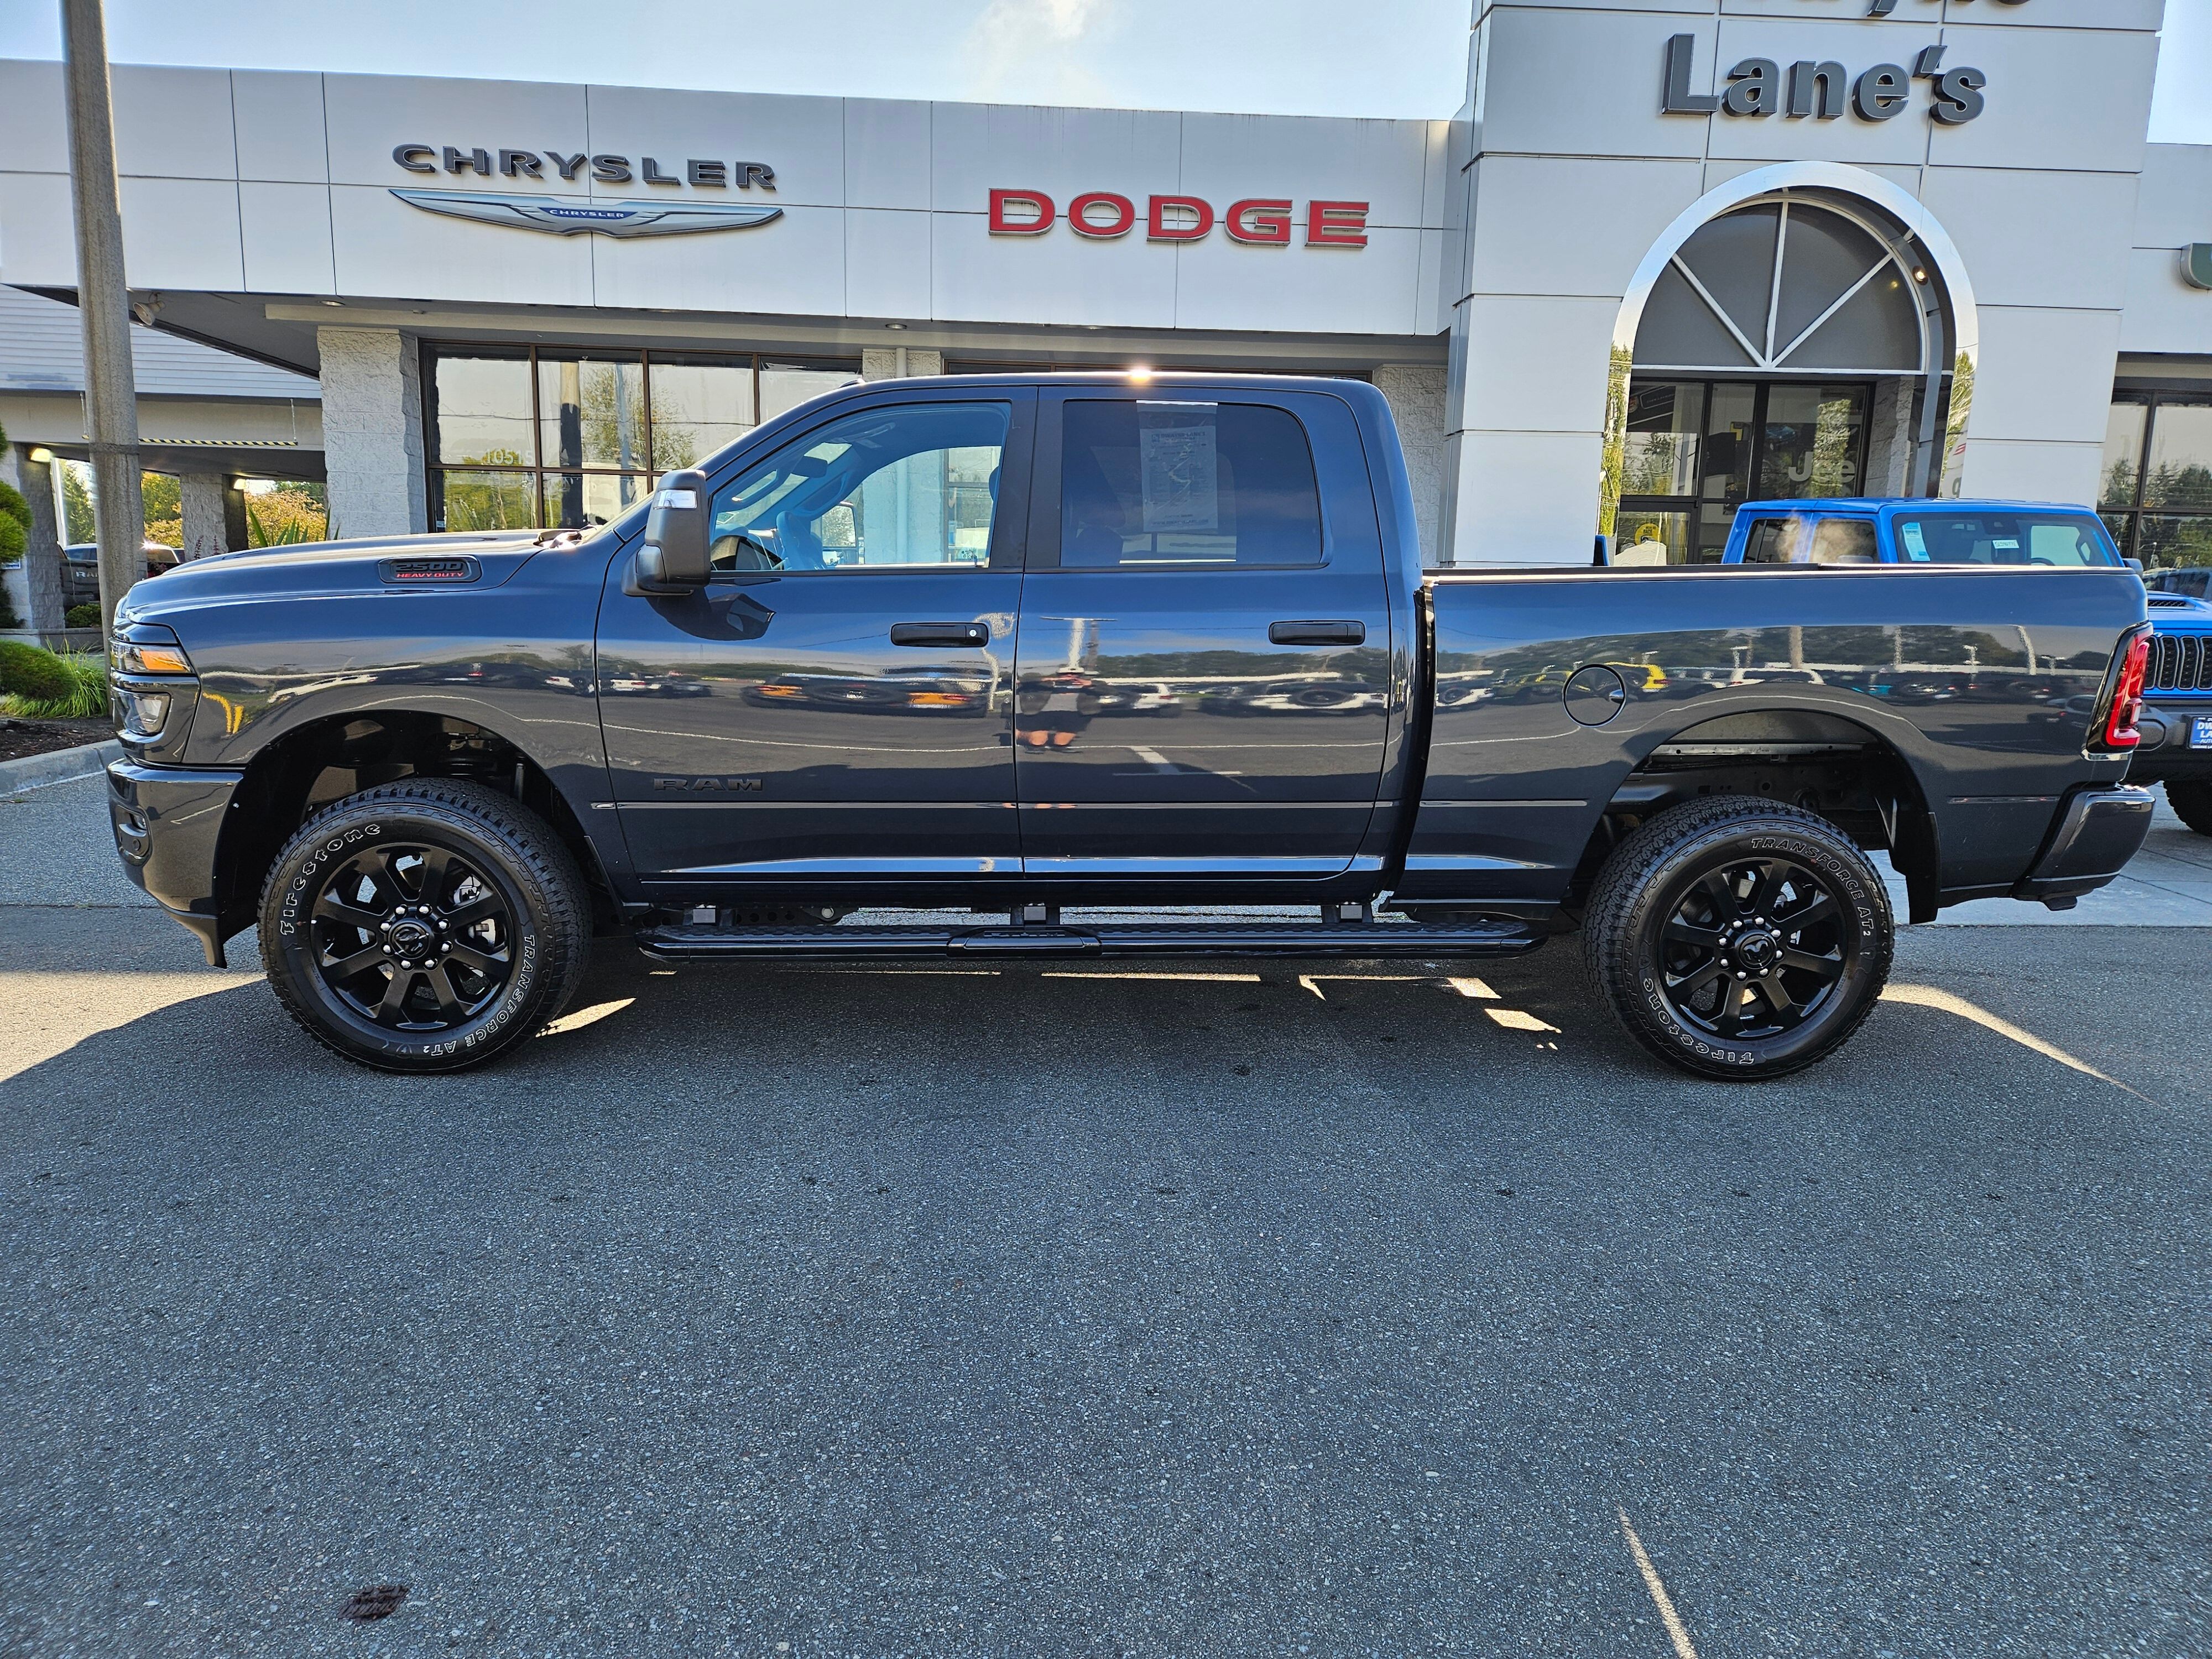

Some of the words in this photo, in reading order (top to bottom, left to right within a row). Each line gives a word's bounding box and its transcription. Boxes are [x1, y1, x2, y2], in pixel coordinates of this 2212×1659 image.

[1661, 33, 1986, 126] Lane's
[392, 143, 776, 191] CHRYSLER
[549, 210, 625, 218] CHRYSLER
[988, 188, 1370, 247] DODGE
[486, 448, 534, 465] 10515
[396, 561, 463, 572] 2500
[654, 778, 763, 791] RAM
[280, 823, 381, 936] Firestone
[1751, 837, 1865, 900] TRANSFORCE
[464, 935, 536, 1047] TRANSFORCE
[1643, 978, 1755, 1065] Firestone
